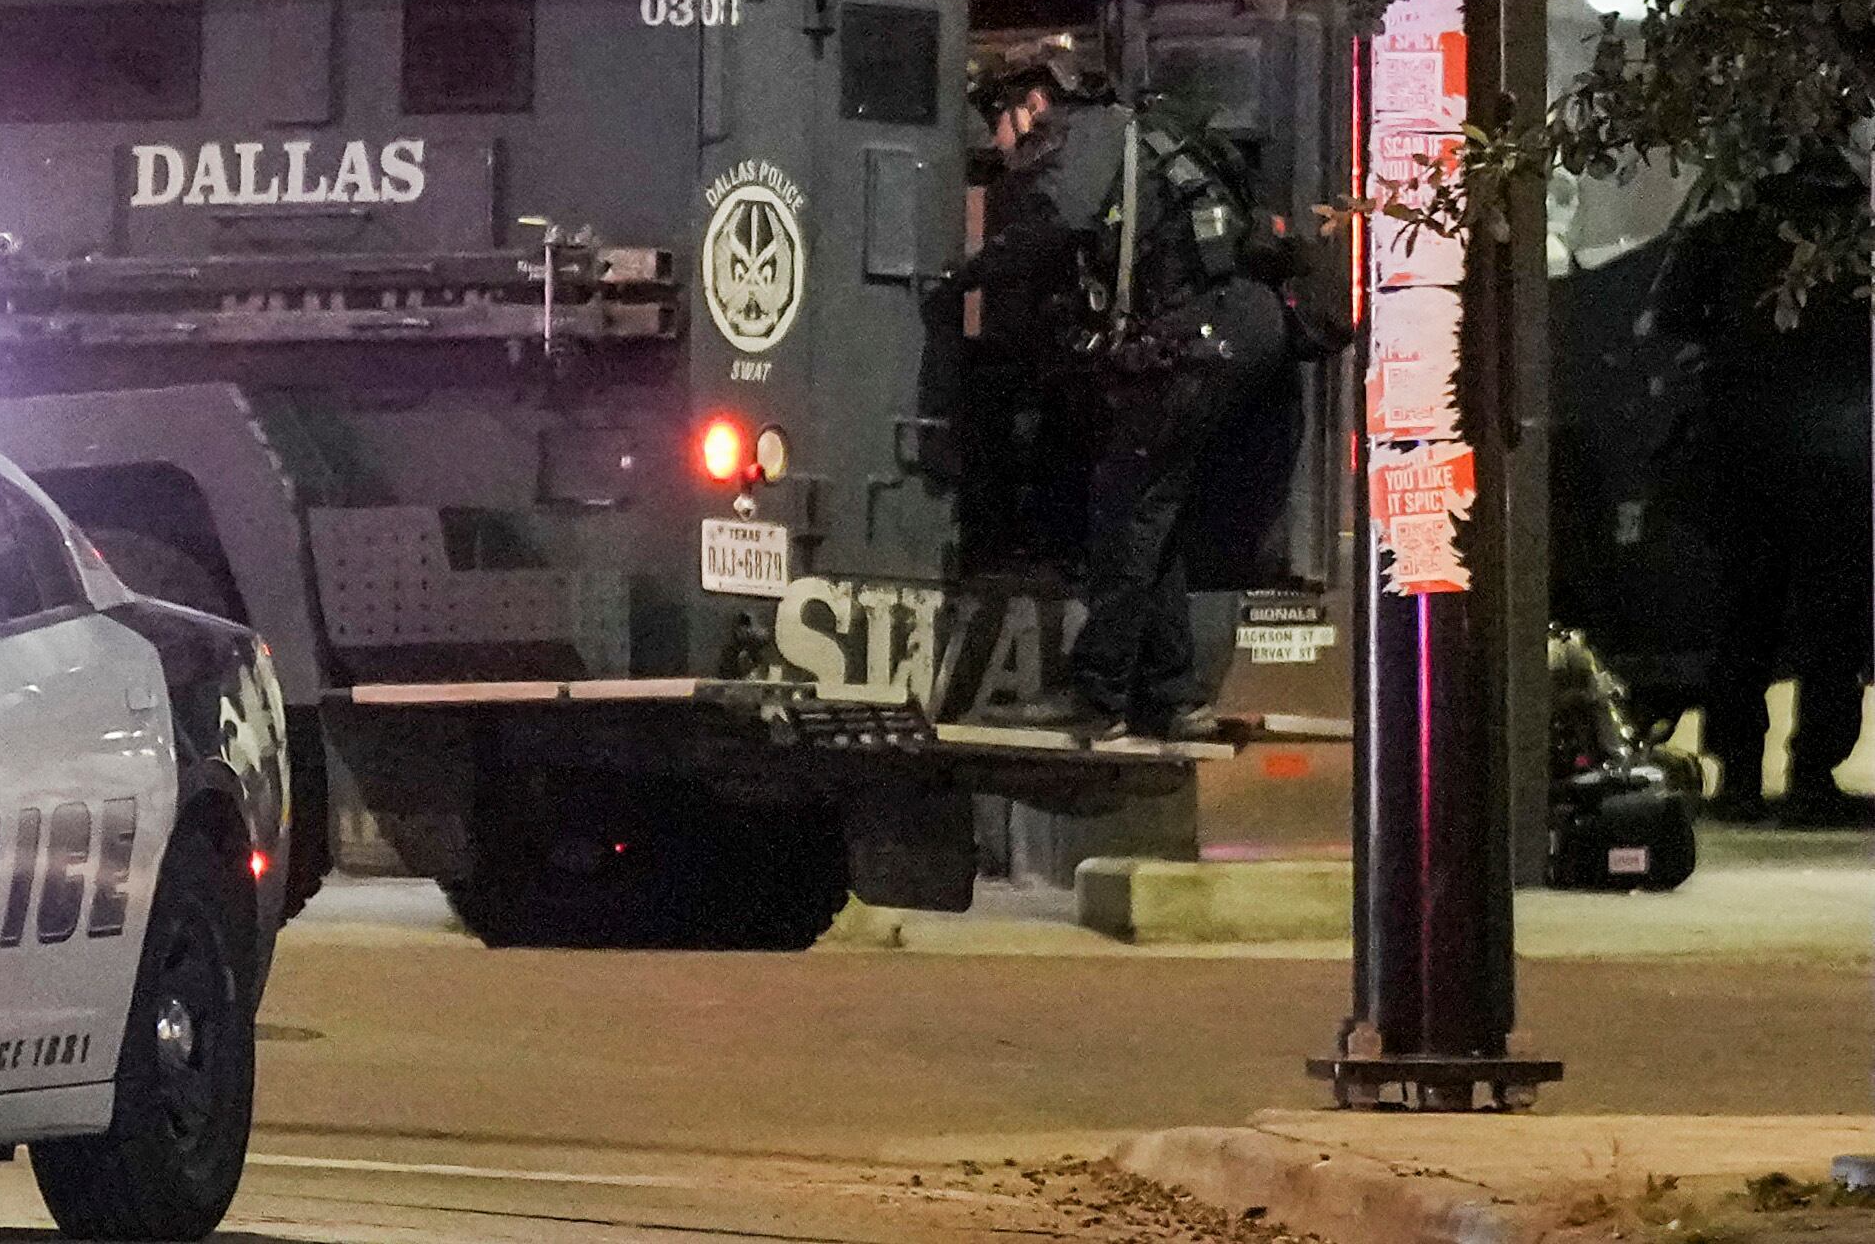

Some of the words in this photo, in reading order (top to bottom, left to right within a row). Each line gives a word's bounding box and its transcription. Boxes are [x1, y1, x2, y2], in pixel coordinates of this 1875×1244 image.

[130, 138, 425, 206] DALLAS
[705, 159, 756, 208] DALLAS
[758, 159, 804, 214] POLICE
[730, 360, 773, 382] SWAT
[1385, 469, 1414, 492] YOU
[1418, 465, 1454, 488] LIKE
[1387, 493, 1401, 515] IT
[775, 576, 1090, 720] SWA
